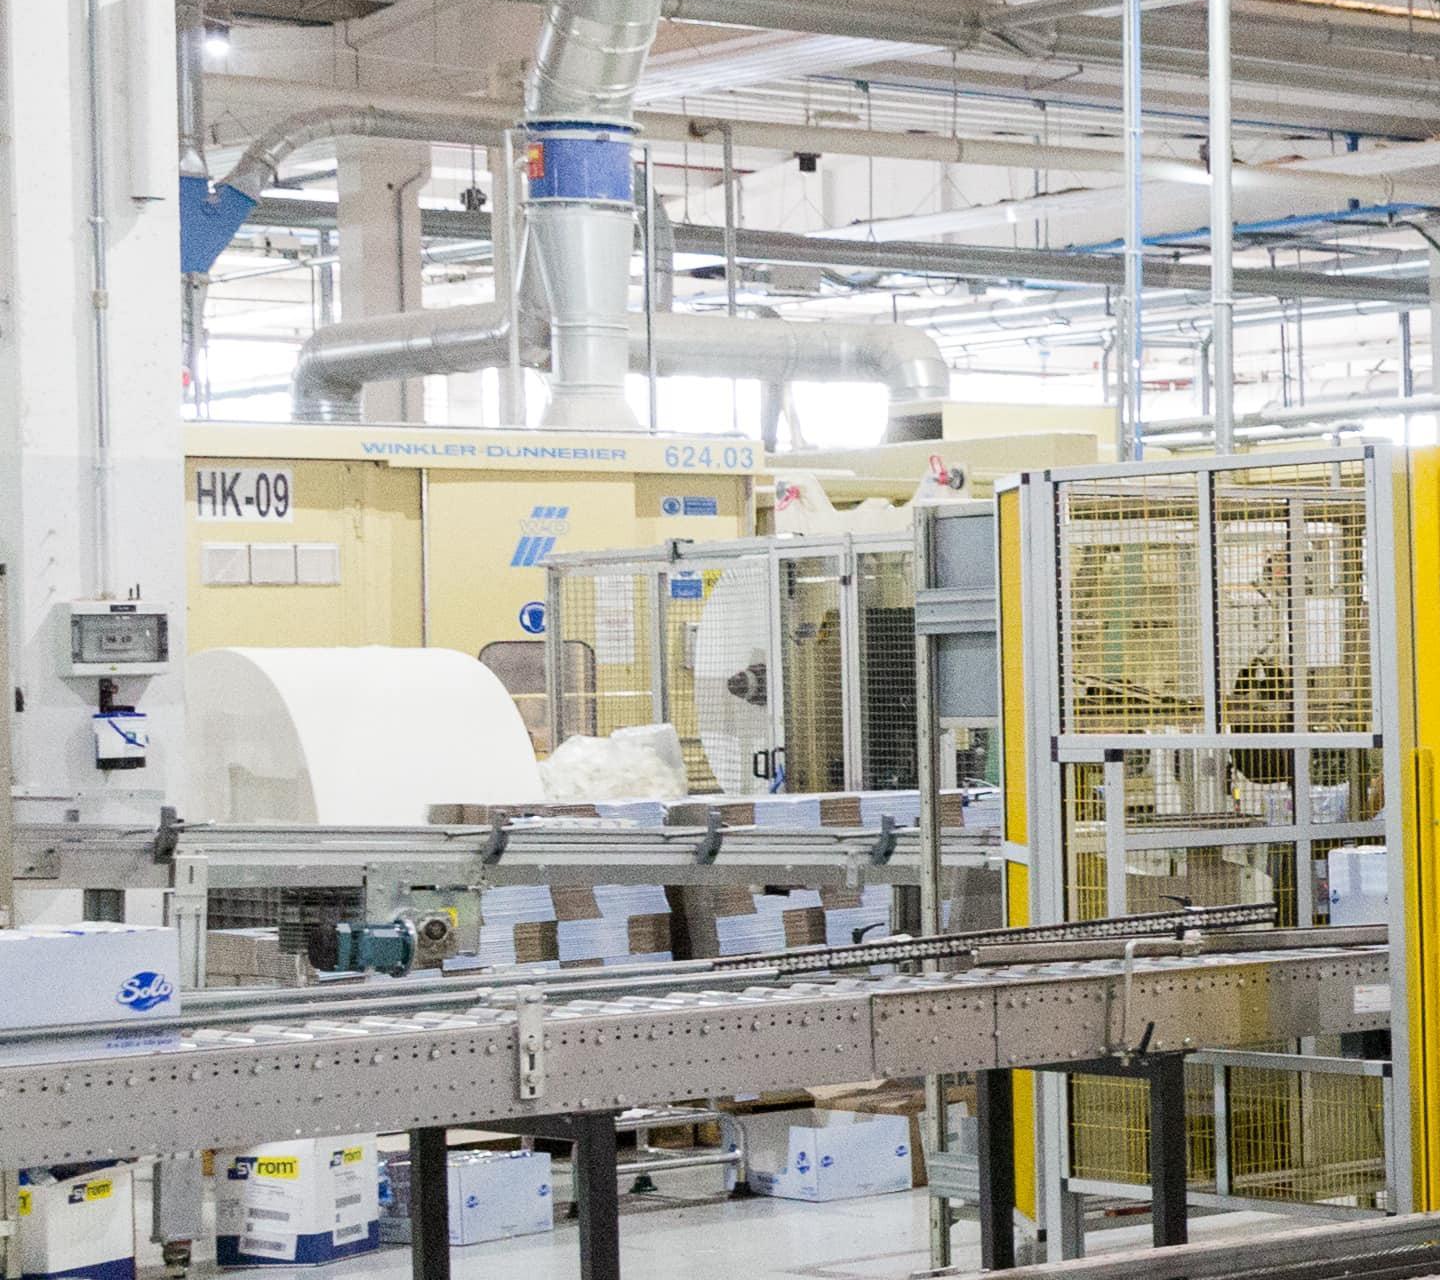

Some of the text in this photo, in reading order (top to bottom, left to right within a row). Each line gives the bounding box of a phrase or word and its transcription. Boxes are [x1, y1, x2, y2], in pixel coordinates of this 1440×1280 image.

[664, 445, 754, 468] 624.03
[196, 471, 289, 518] HK-09
[116, 973, 173, 1004] Solo
